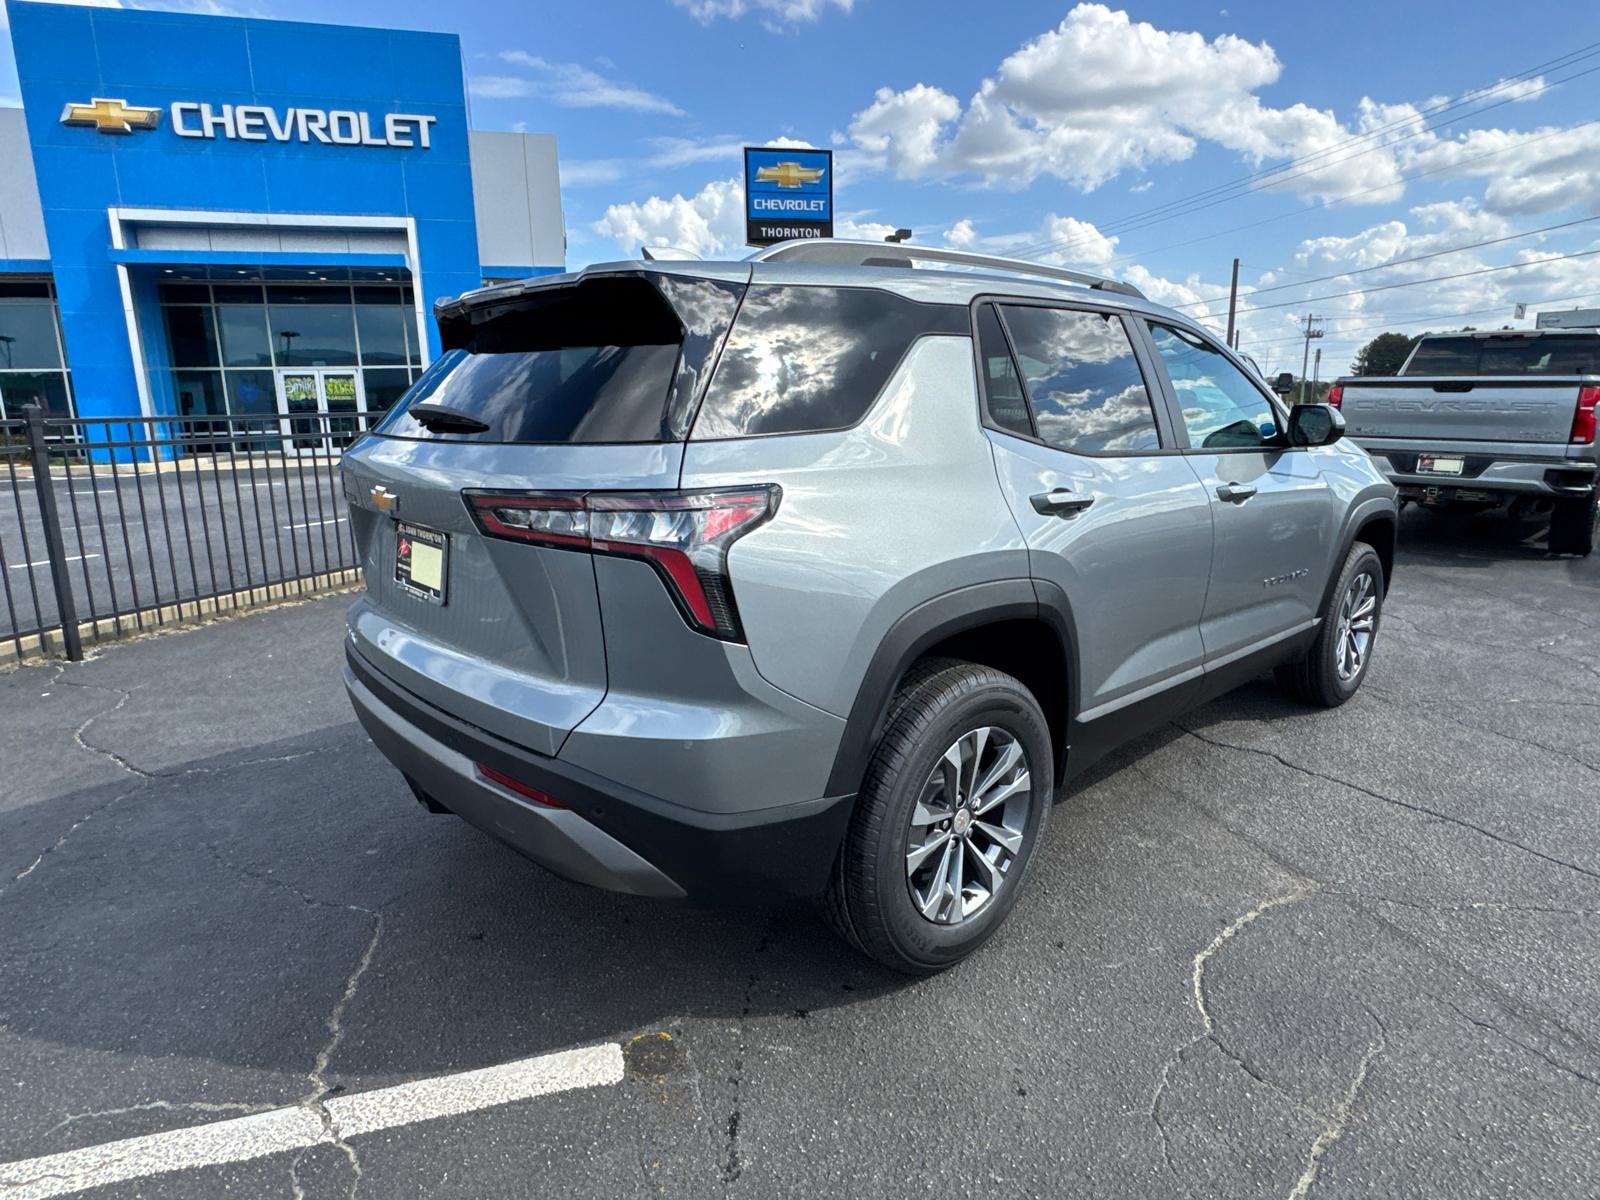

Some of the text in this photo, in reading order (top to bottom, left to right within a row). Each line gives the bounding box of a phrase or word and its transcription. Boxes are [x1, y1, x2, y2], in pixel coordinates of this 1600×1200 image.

[170, 101, 437, 149] CHEVROLET
[754, 199, 825, 211] CHEVROLET
[761, 227, 821, 238] THORNTON
[1353, 399, 1559, 414] CHEVROLET
[405, 525, 417, 536] JOHN
